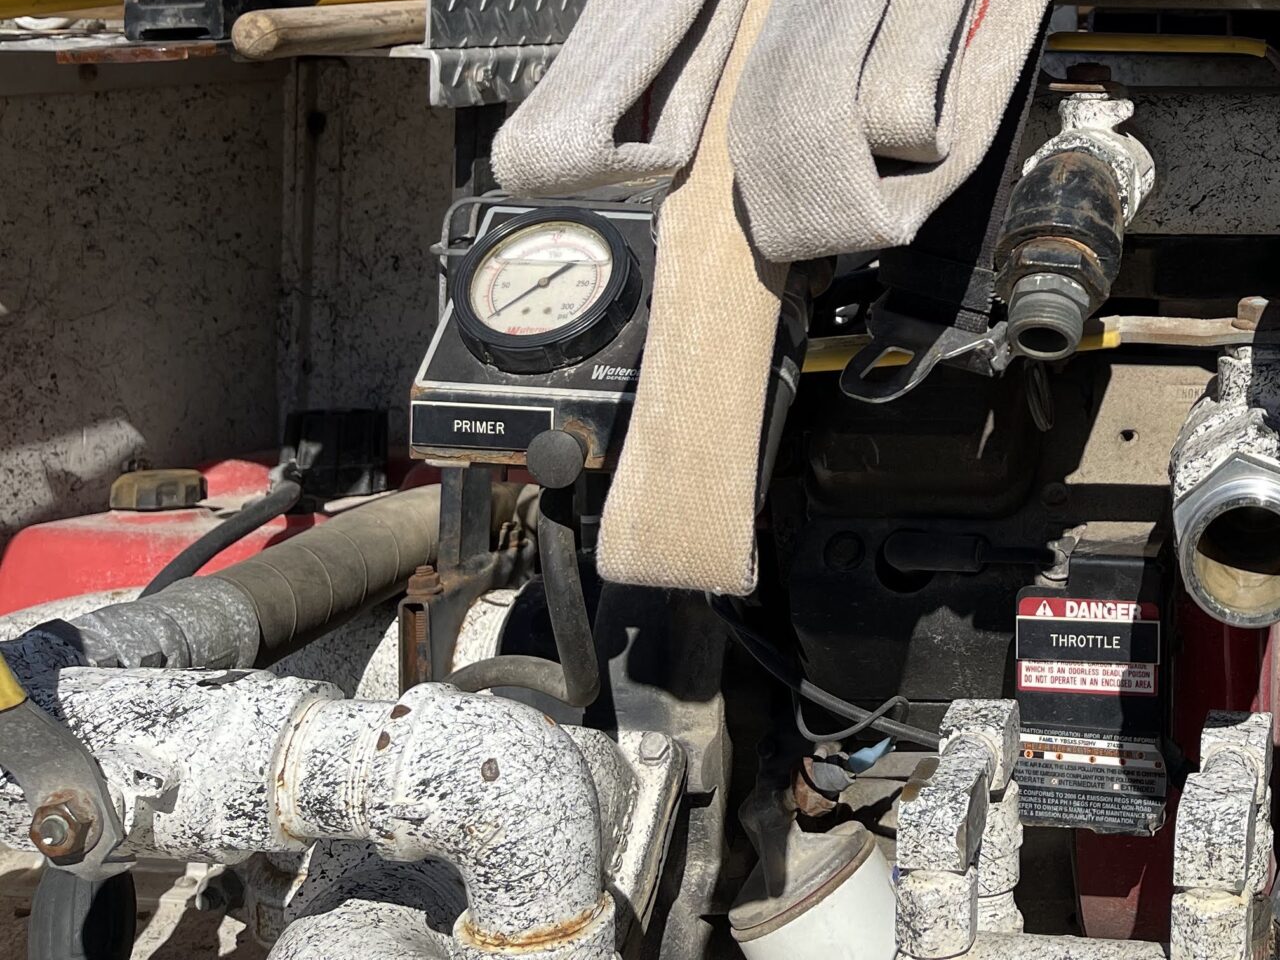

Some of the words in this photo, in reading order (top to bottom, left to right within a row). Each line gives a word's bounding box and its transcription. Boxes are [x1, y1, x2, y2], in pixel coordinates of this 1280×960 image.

[576, 279, 590, 287] 250
[591, 364, 640, 380] Watero
[453, 419, 505, 435] PRIMER
[1065, 600, 1142, 620] DANGER
[1050, 633, 1121, 649] THROTTLE
[1024, 665, 1046, 673] WHICH
[1048, 666, 1054, 674] IS
[1057, 667, 1066, 675] AN
[1068, 667, 1100, 676] ODORLESS
[1102, 668, 1126, 678] DEADLY
[1128, 670, 1151, 679] POISON
[1024, 674, 1033, 683] DO
[1035, 674, 1048, 684] NOT
[1050, 675, 1077, 686] OPERATE
[1080, 677, 1087, 686] IN
[1089, 677, 1099, 686] AN
[1101, 677, 1133, 689] ENCLOSED
[1134, 679, 1152, 689] AREA
[1044, 728, 1081, 738] CORPORATION
[1015, 775, 1045, 784] ODERATE
[1058, 779, 1106, 789] INTERMEDIATE
[1121, 784, 1155, 793] EXTENDED
[1023, 789, 1055, 798] CONFORMS
[1086, 794, 1113, 802] EMISSION
[1143, 799, 1162, 807] SMALL
[1105, 810, 1146, 819] MAINTENANCE
[1121, 804, 1152, 813] NON-ROAD
